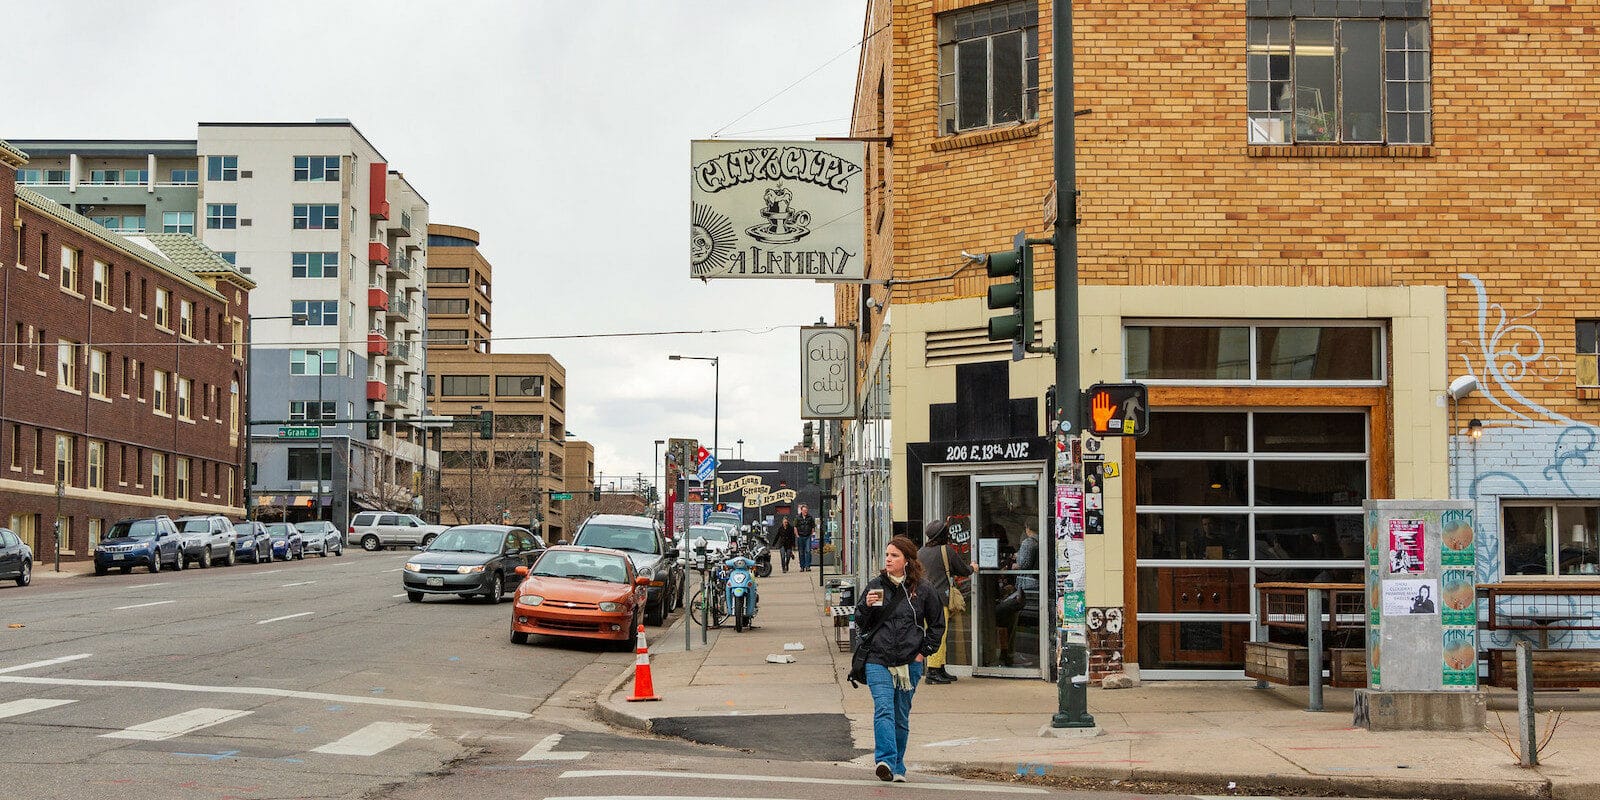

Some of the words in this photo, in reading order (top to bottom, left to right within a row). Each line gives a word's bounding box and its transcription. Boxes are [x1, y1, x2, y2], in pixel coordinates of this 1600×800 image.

[694, 148, 778, 193] CITY
[780, 147, 862, 193] CITY
[728, 250, 746, 274] A
[750, 246, 857, 275] LAMENT
[810, 340, 846, 382] city
[287, 428, 308, 437] Grant
[946, 445, 967, 461] 206
[970, 445, 981, 460] E.
[982, 443, 1004, 460] 13th
[1004, 441, 1029, 458] AVE
